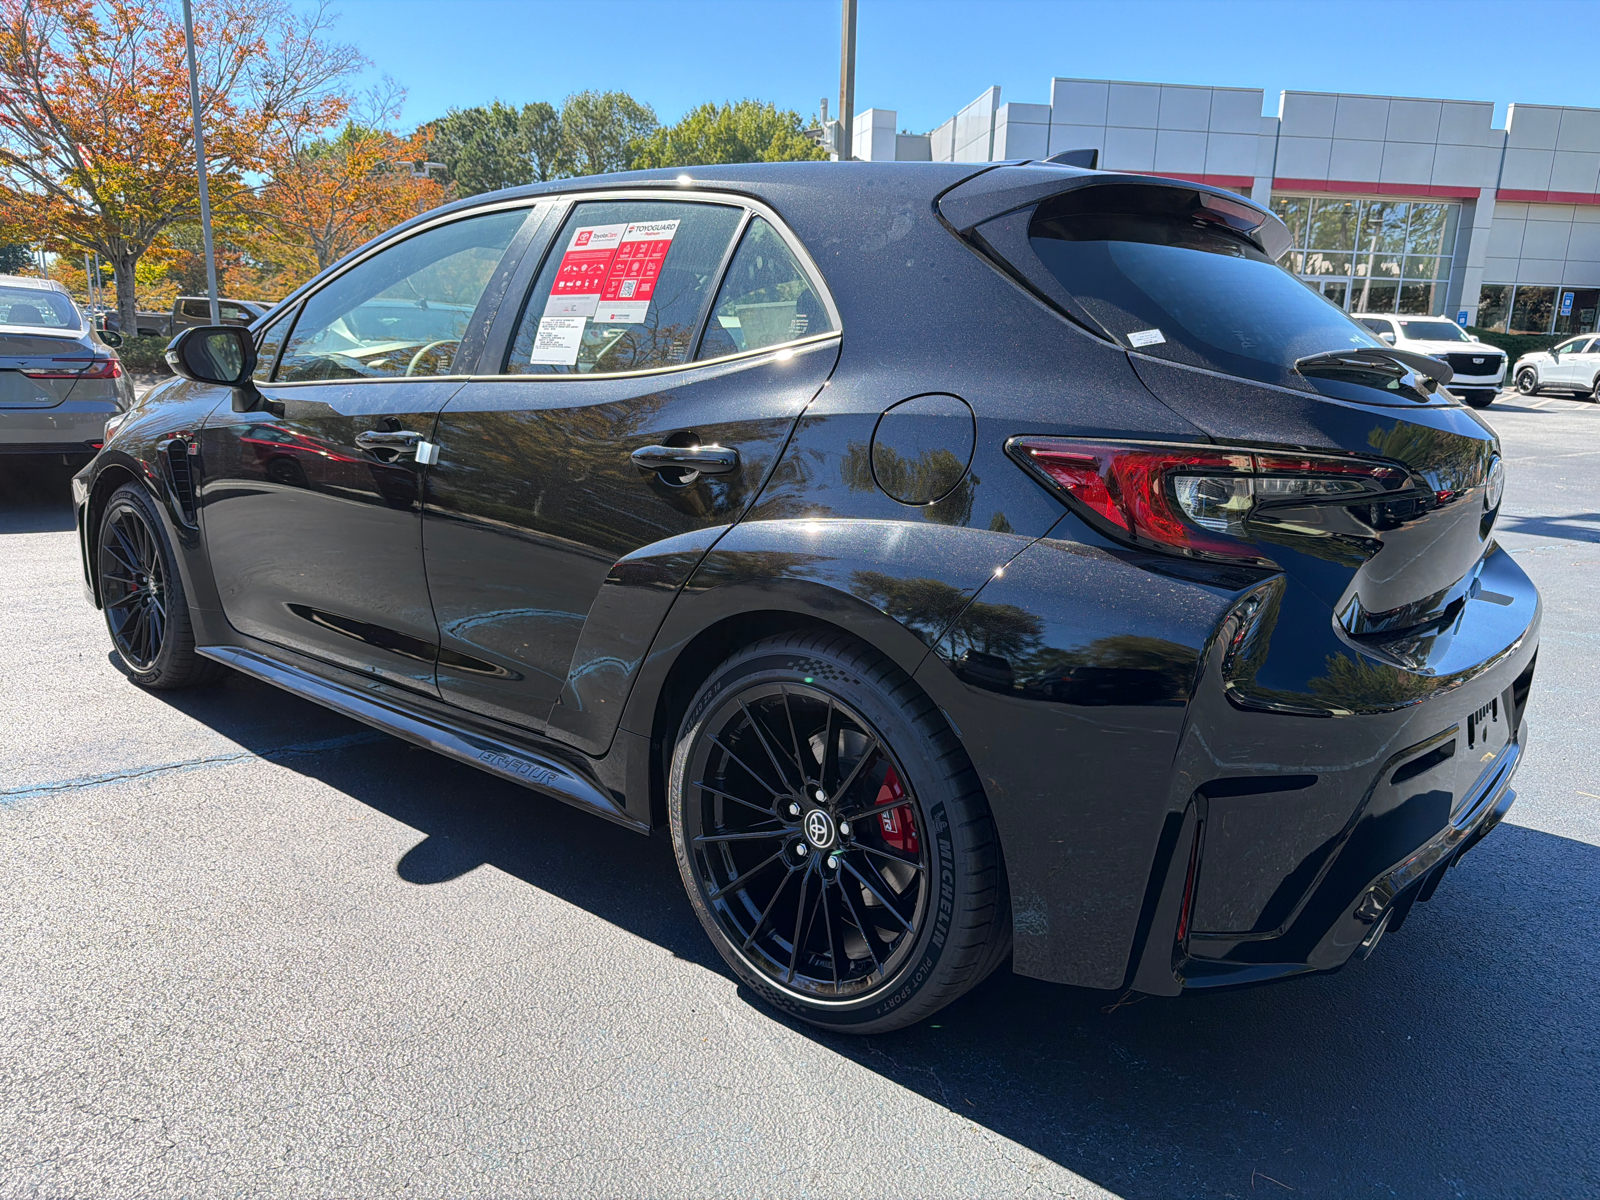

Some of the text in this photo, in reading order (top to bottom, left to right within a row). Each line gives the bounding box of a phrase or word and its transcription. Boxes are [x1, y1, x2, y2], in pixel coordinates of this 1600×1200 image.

[635, 223, 676, 232] TOYOGUARD
[932, 838, 954, 949] MICHELIN
[911, 956, 933, 988] PILOT
[883, 985, 912, 1011] SPORT
